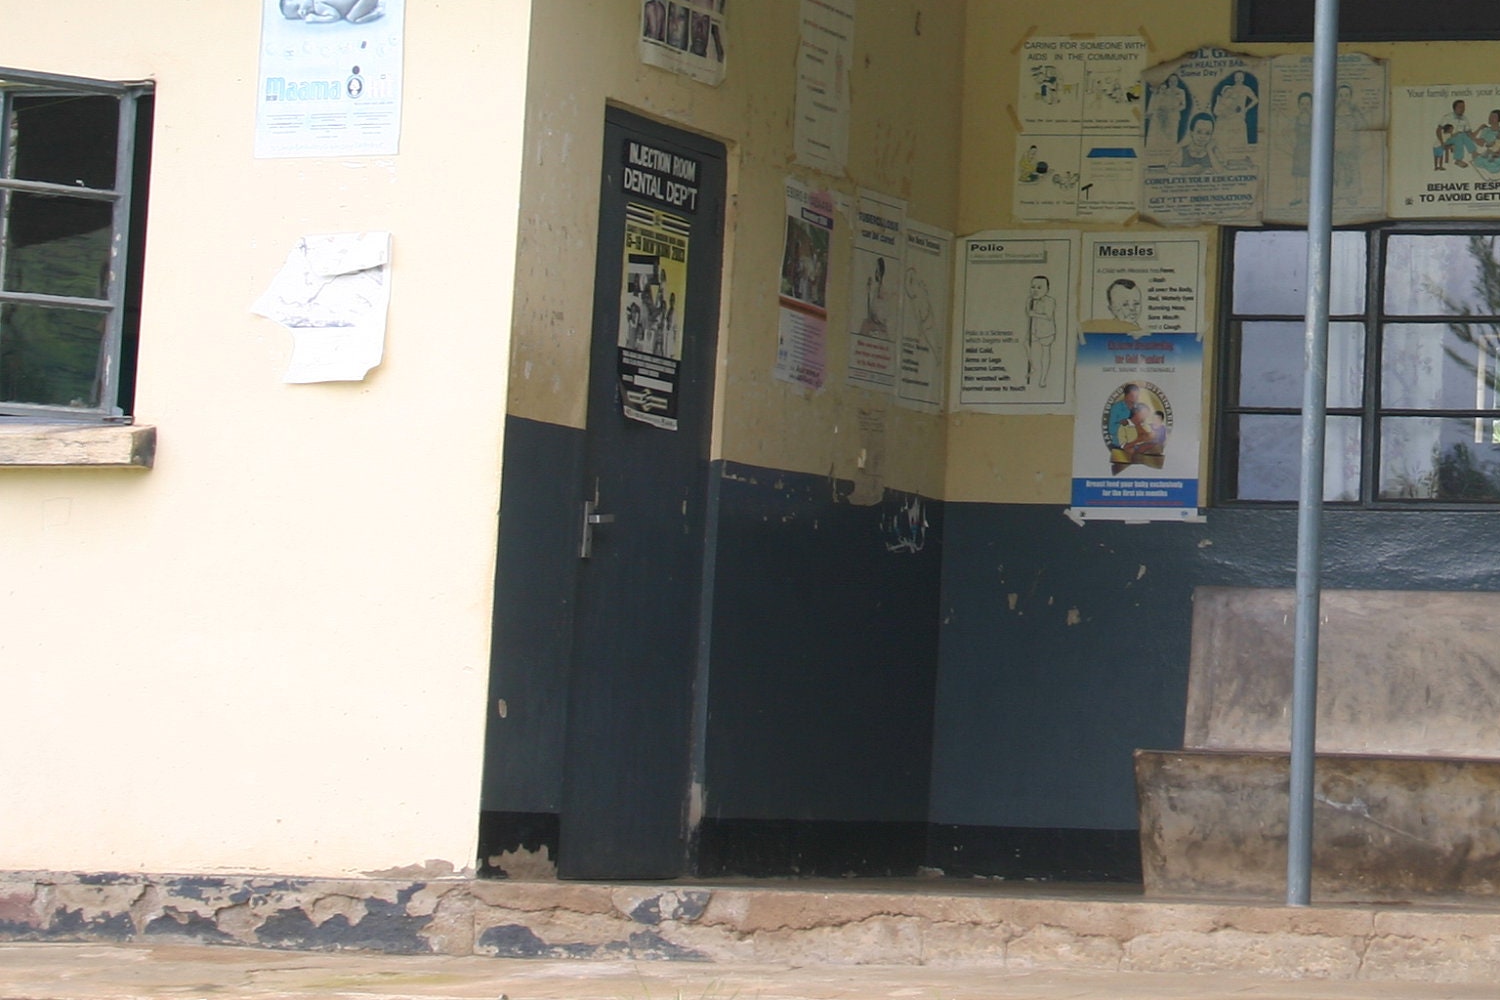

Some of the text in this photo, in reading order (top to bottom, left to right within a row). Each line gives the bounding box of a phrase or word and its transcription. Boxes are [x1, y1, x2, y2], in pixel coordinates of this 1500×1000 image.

[1028, 53, 1047, 61] AIDS
[266, 77, 341, 101] Maama
[1407, 89, 1424, 98] Your
[1427, 89, 1448, 98] family
[1451, 89, 1472, 97] needs
[1476, 90, 1493, 98] your
[629, 142, 696, 182] INJECTION ROOM
[624, 167, 664, 200] DENTAL
[1145, 177, 1185, 185] COMPLETE
[1428, 183, 1469, 191] BEHAVE
[1420, 194, 1434, 202] TO
[1438, 193, 1472, 201] AVOID
[971, 244, 1004, 252] Polio
[1099, 246, 1153, 256] Measles
